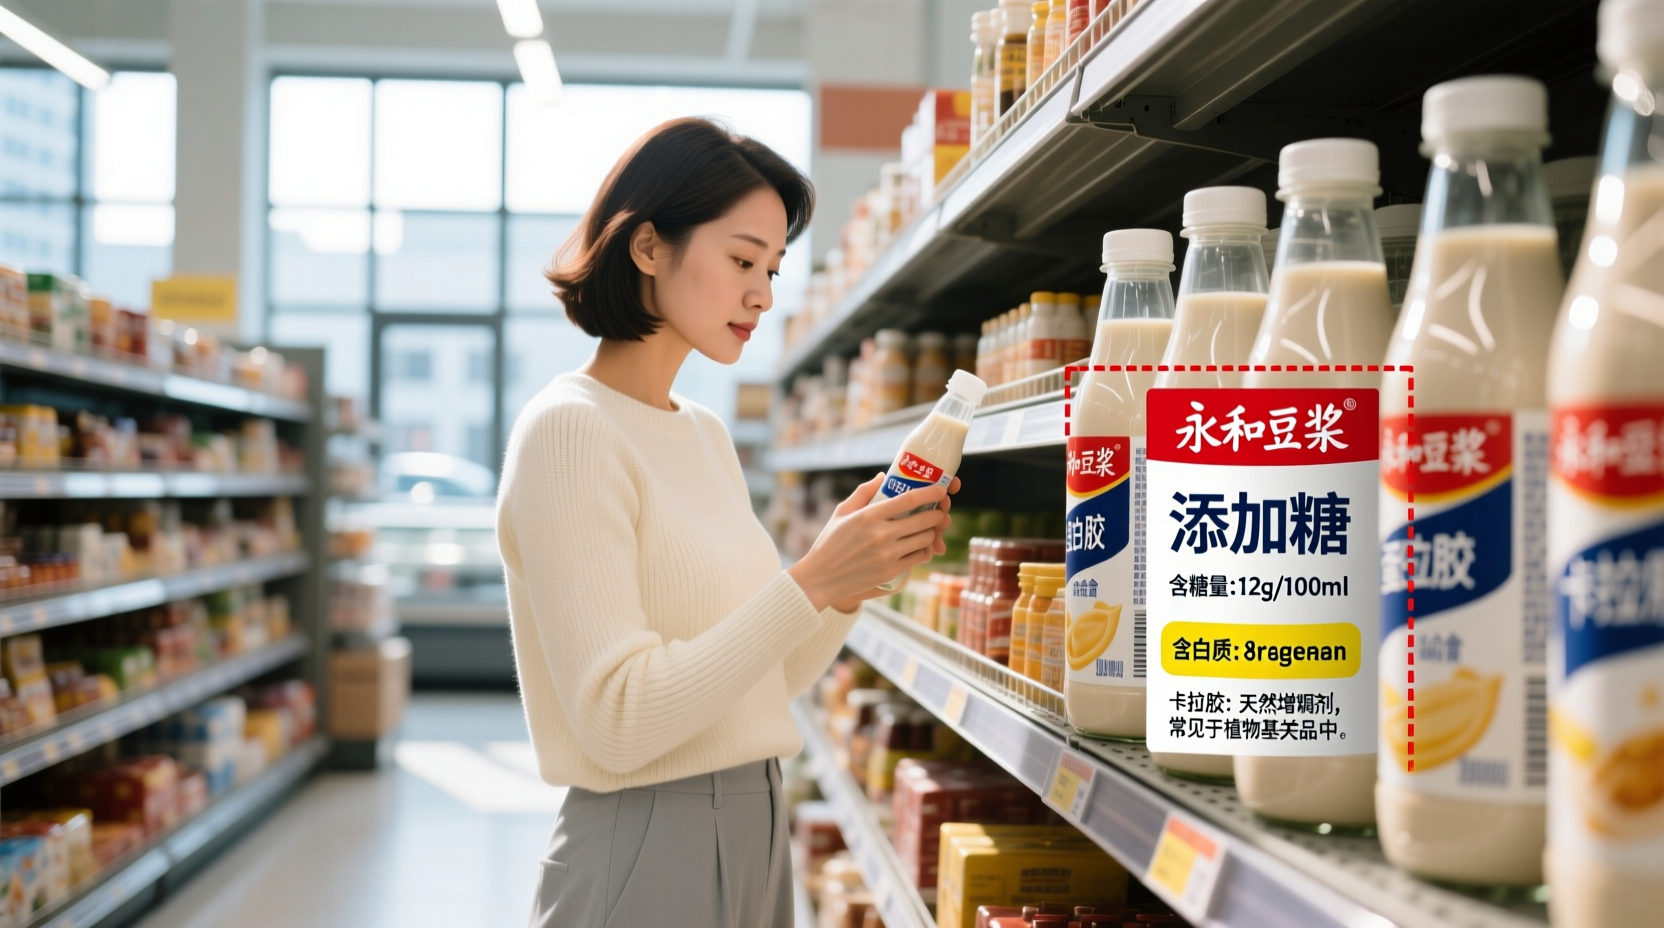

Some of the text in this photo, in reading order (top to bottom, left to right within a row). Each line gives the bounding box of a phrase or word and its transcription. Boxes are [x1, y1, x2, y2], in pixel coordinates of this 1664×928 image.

[1175, 400, 1350, 454] 永和豆浆
[1169, 491, 1351, 555] 添加糖
[1169, 573, 1349, 602] 含糖量:12g/100ml
